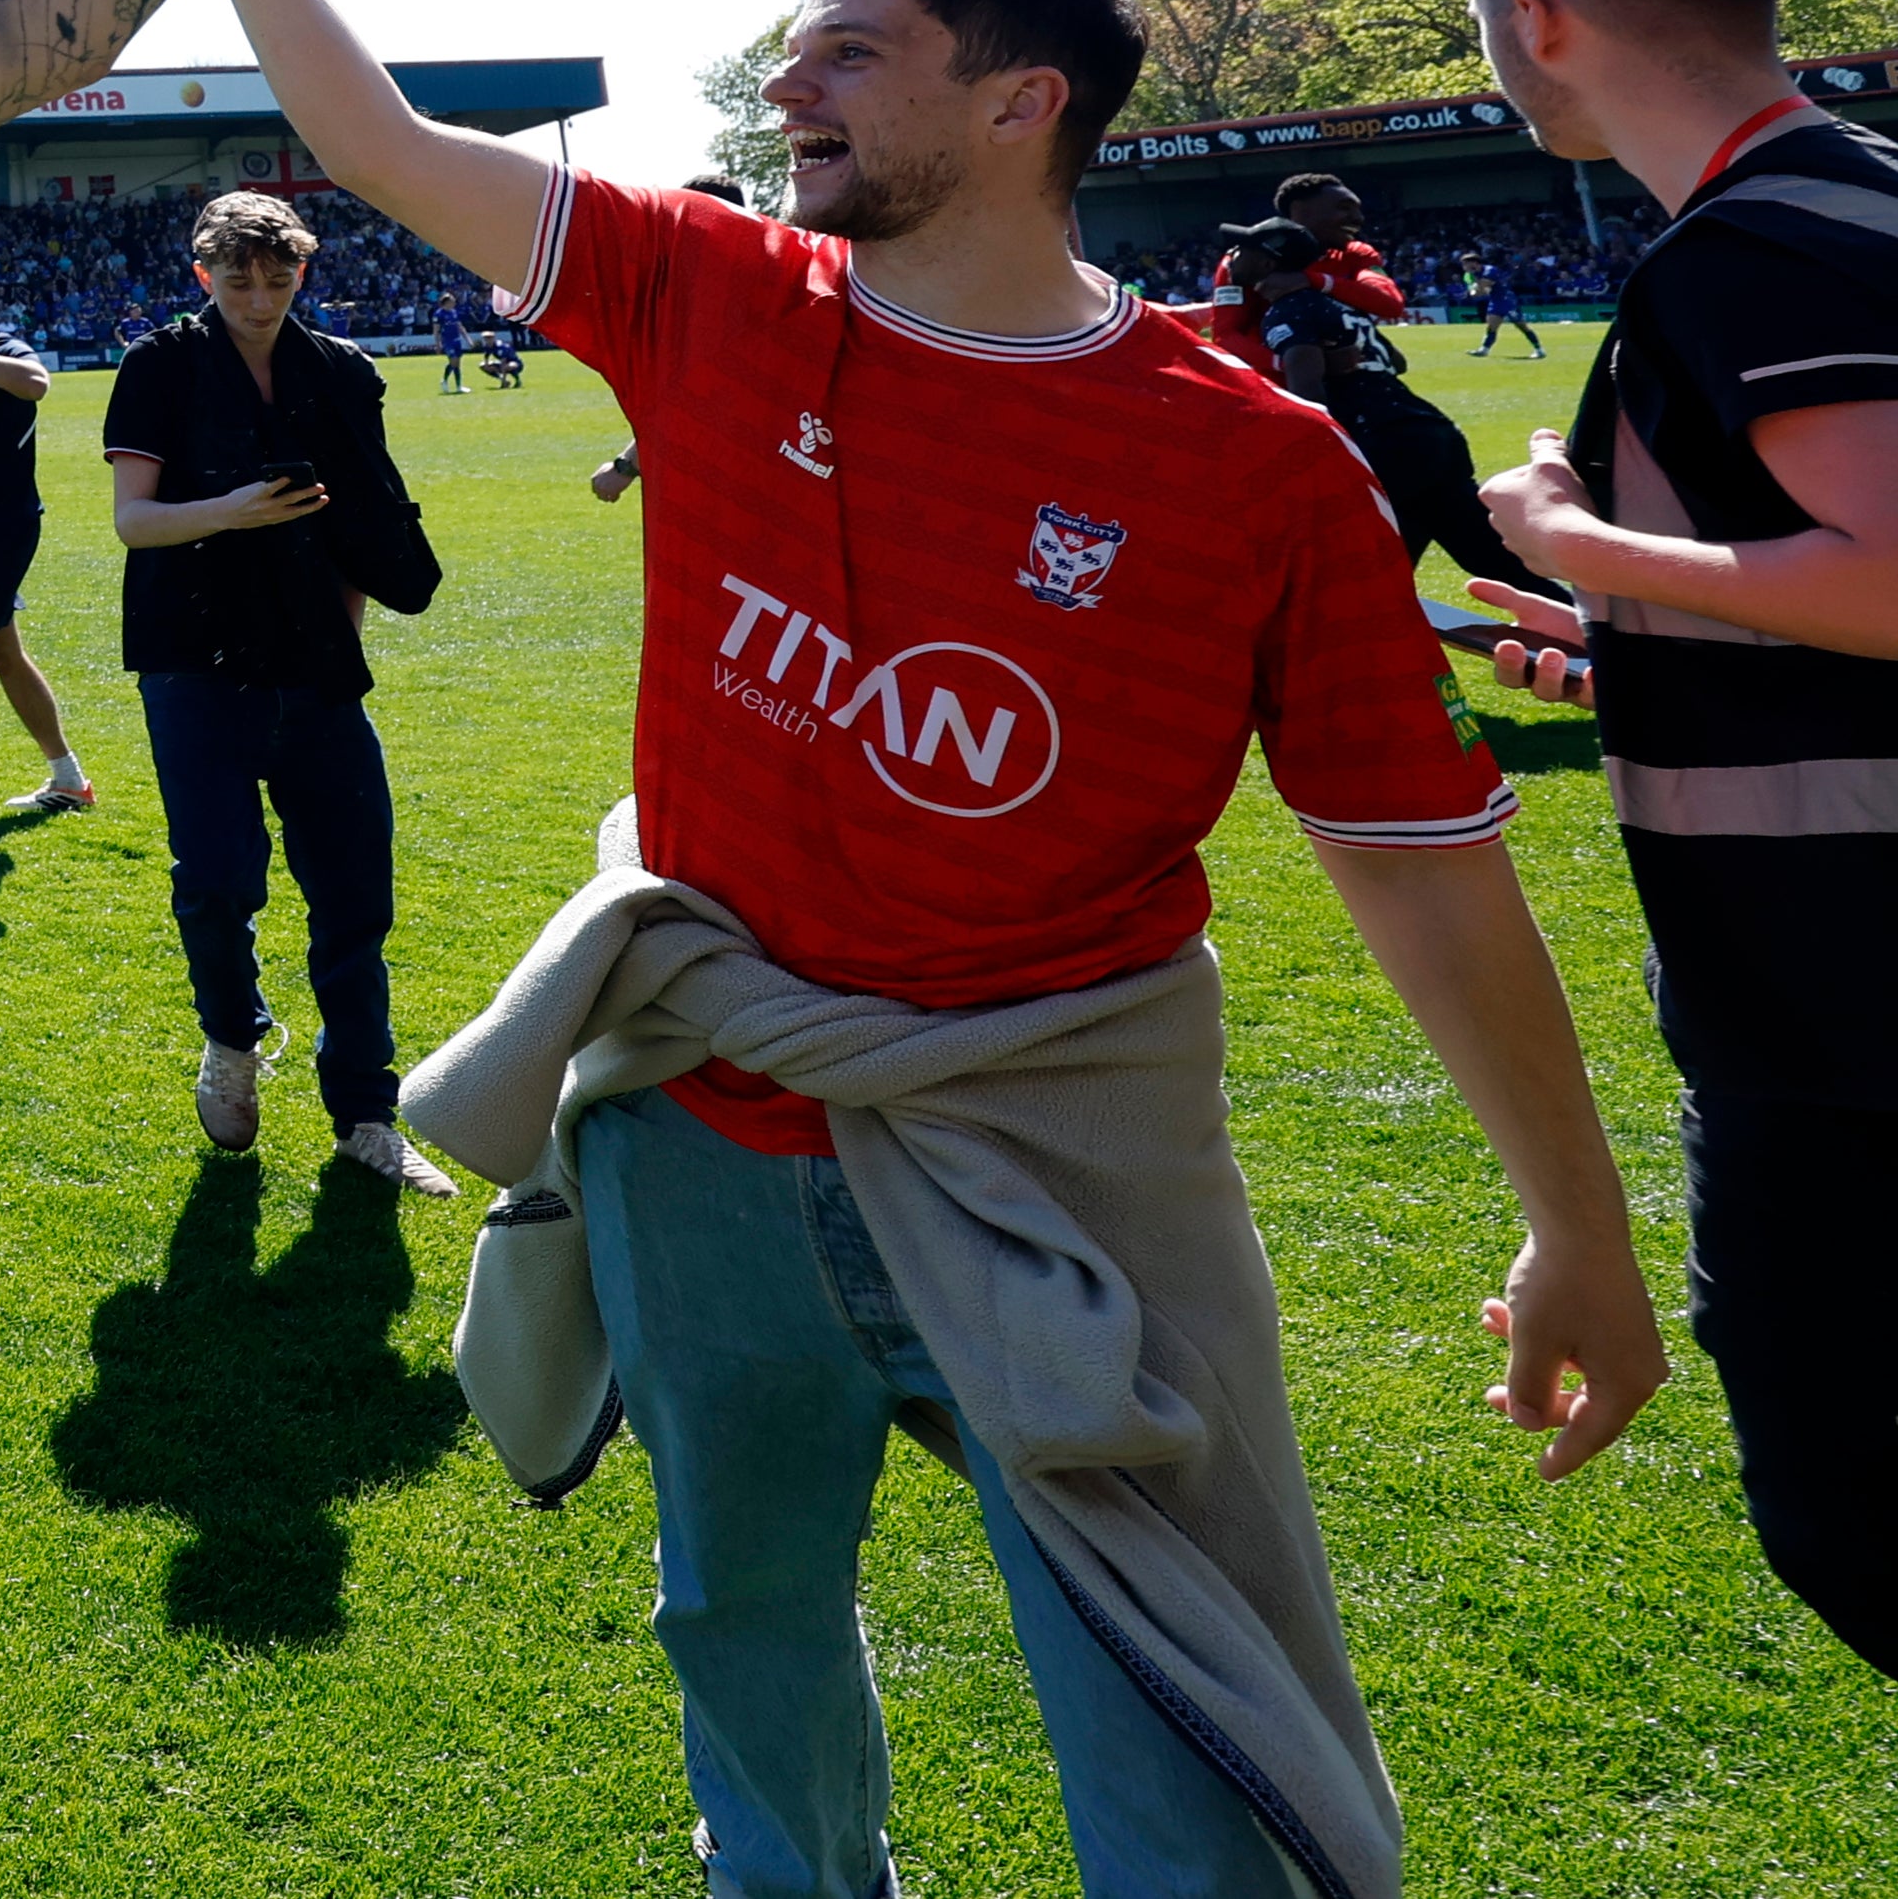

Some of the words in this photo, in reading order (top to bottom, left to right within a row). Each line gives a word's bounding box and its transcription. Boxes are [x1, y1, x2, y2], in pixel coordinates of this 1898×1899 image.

[40, 90, 126, 112] rena
[1098, 140, 1134, 164] for
[1139, 134, 1210, 160] Bolts
[1256, 106, 1461, 145] www.bapp.co.uk
[778, 438, 835, 479] hummel
[1046, 511, 1082, 530] YORK
[1083, 524, 1117, 539] CITY
[713, 661, 819, 744] Wealth
[718, 573, 1018, 788] TITAN
